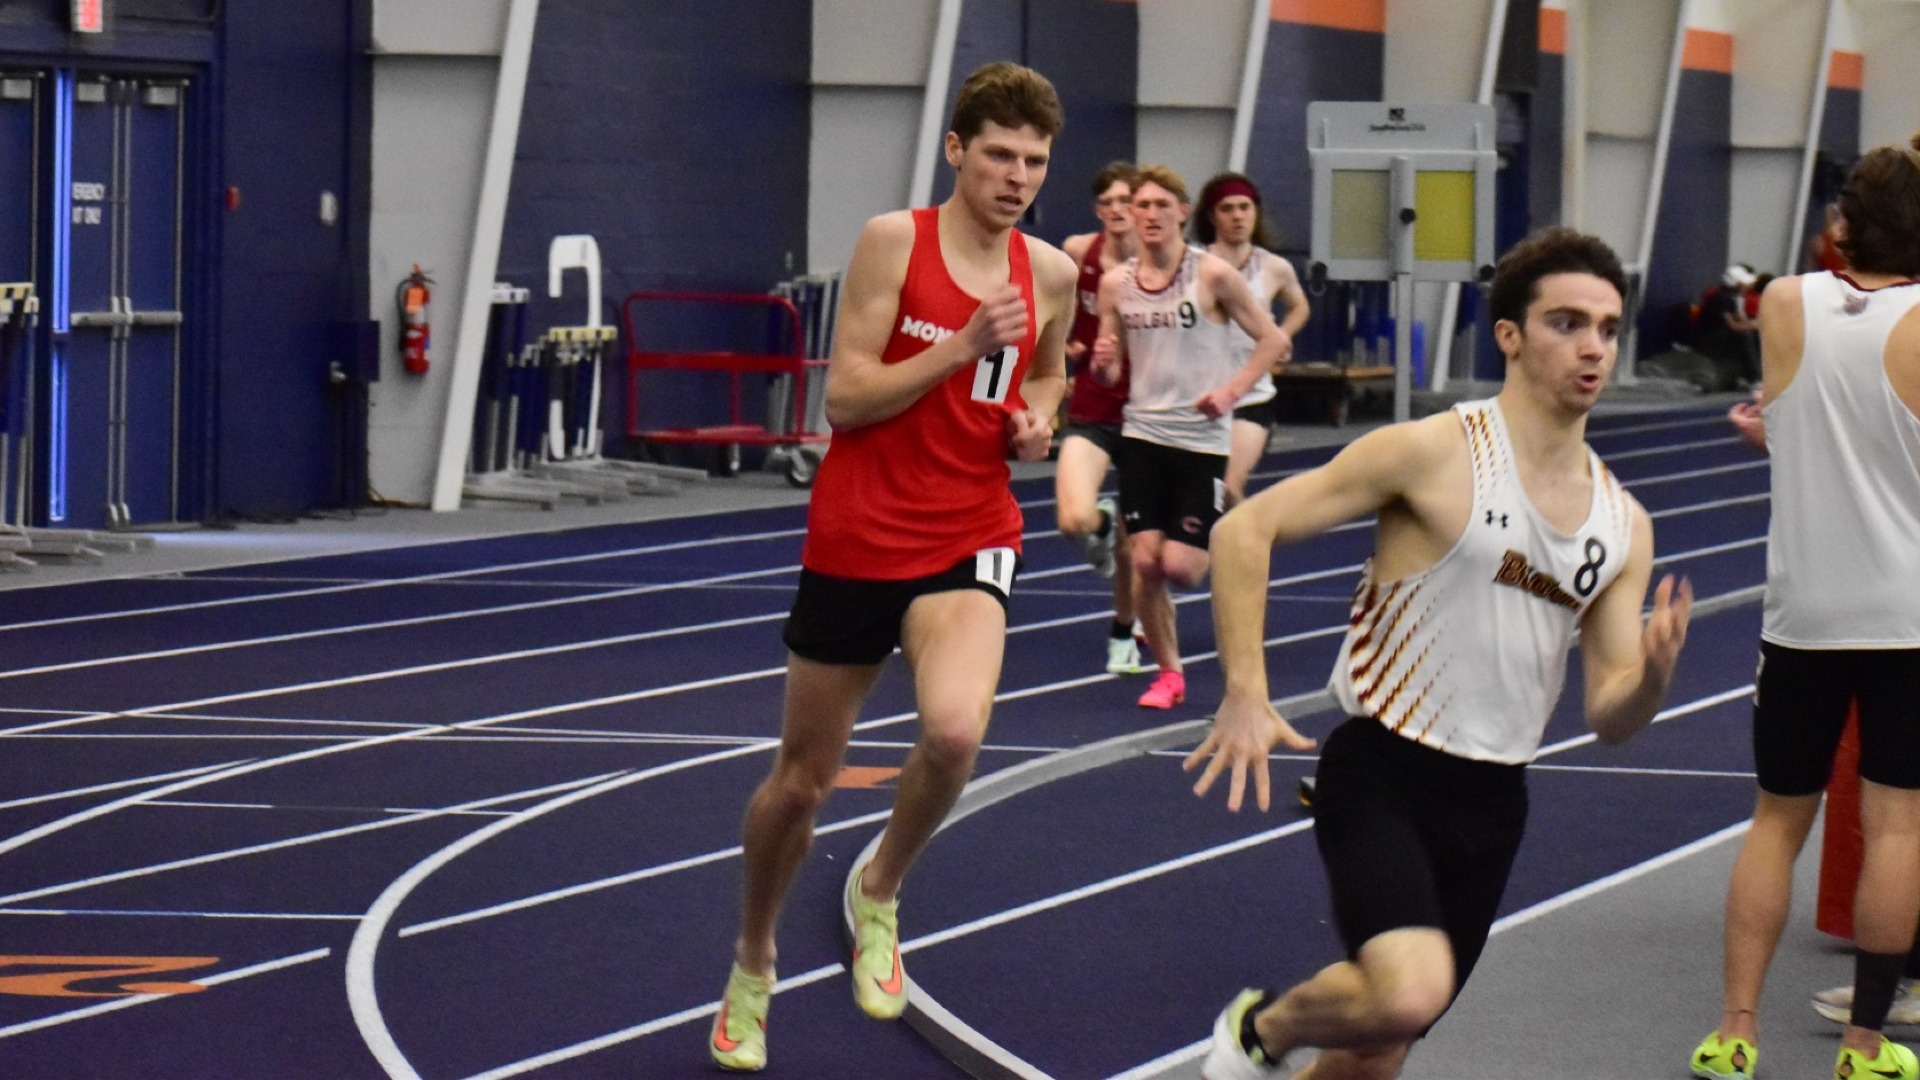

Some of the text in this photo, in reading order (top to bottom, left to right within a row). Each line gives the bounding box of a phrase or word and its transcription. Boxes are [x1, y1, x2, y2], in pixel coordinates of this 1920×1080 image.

[1122, 311, 1177, 329] COLGAT
[1178, 300, 1197, 329] 9
[901, 315, 955, 345] MON
[985, 350, 1005, 400] 1
[1574, 537, 1607, 597] 8
